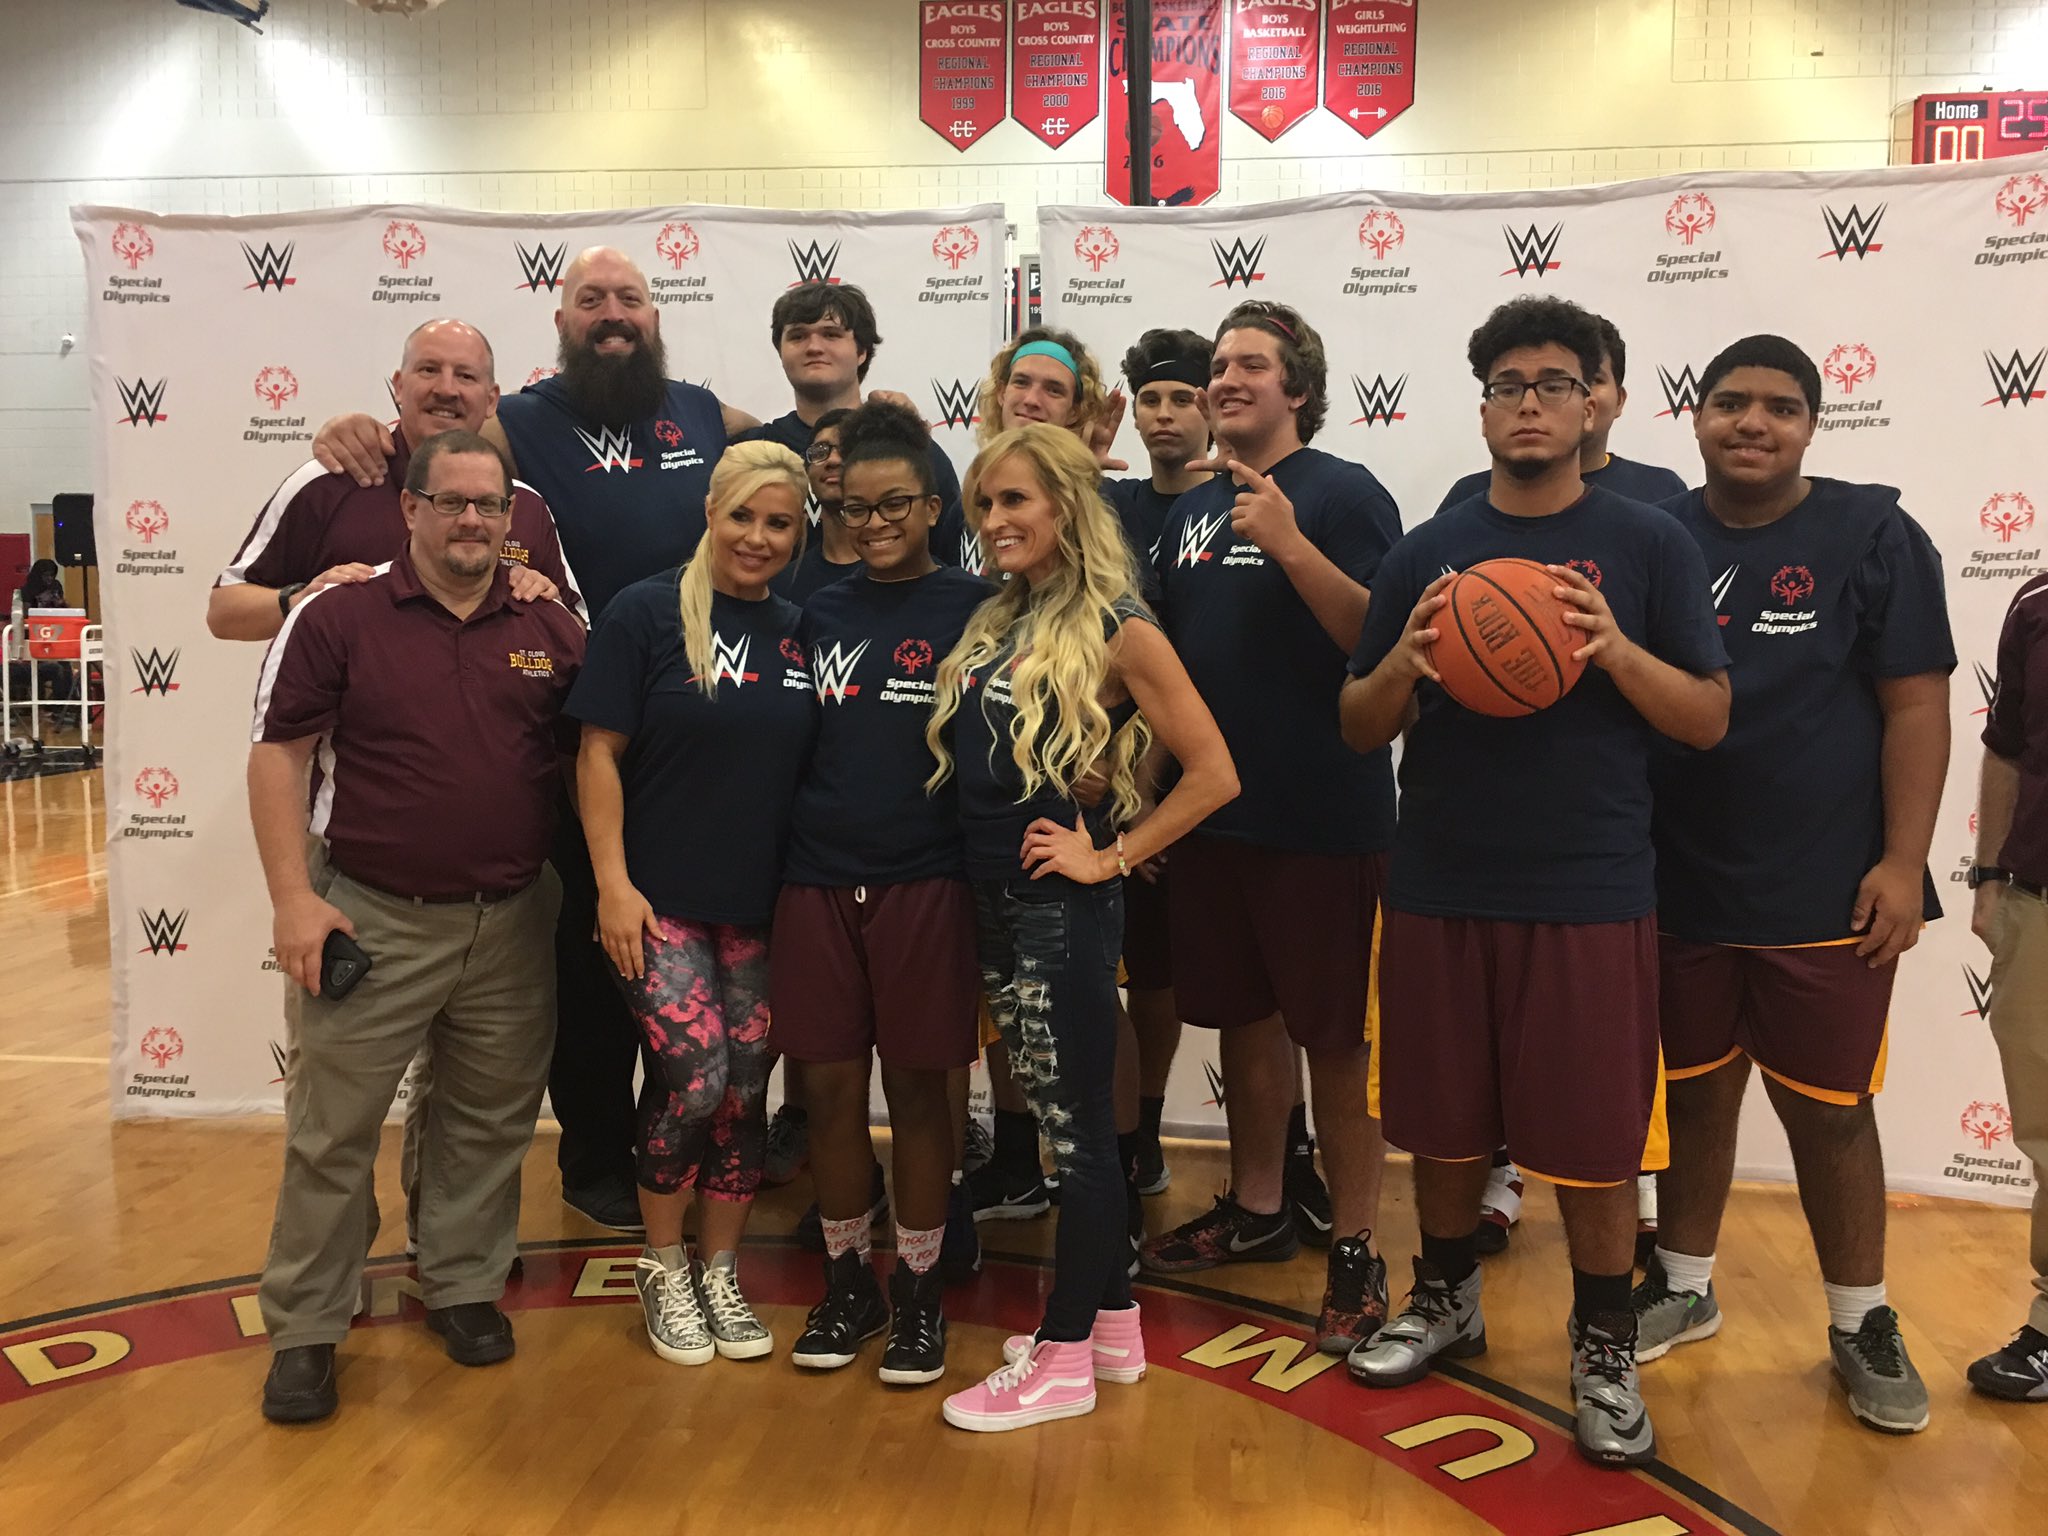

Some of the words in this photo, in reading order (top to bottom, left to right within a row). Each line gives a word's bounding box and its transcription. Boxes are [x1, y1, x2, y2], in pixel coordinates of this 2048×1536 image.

[925, 4, 1002, 24] EAGLES
[1018, 1, 1096, 22] EAGLES
[1355, 10, 1385, 20] GIRLS
[1262, 14, 1289, 24] BOYS
[951, 25, 976, 34] BOYS
[1044, 22, 1069, 31] BOYS
[1243, 27, 1306, 38] BASKETBALL
[1336, 23, 1406, 34] WEIGHTLIFTING
[925, 38, 955, 48] CROSS
[958, 37, 1001, 48] COUNTRY
[1018, 36, 1048, 46] CROSS
[1051, 34, 1095, 45] COUNTRY
[1248, 46, 1302, 60] REGIONAL
[1343, 42, 1398, 56] REGIONAL
[937, 56, 989, 70] REGIONAL
[1030, 53, 1083, 67] REGIONAL
[1242, 66, 1306, 80] CHAMPIONS
[1338, 62, 1403, 76] CHAMPIONS
[932, 76, 994, 90] CHAMPIONS
[1025, 74, 1088, 88] CHAMPIONS
[1261, 86, 1286, 101] 2016
[1357, 83, 1382, 96] 2016
[952, 97, 975, 110] 1999
[1043, 95, 1069, 108] 2000
[1935, 101, 1979, 120] Home
[1935, 125, 1984, 163] 00
[1656, 251, 1722, 268] Special
[1974, 248, 2048, 266] Olympic
[1351, 266, 1410, 280] Special
[1647, 267, 1729, 284] Olympics
[109, 275, 162, 289] Special
[378, 274, 433, 289] Special
[651, 276, 706, 290] Special
[926, 275, 983, 290] Special
[1069, 277, 1125, 291] Special
[1343, 281, 1417, 296] Olympics
[103, 290, 170, 304] Olympics
[372, 289, 441, 303] Olympics
[918, 289, 989, 305] Olympics
[1062, 291, 1132, 305] Olympics
[250, 416, 305, 431] Special
[1818, 416, 1890, 431] lympics
[243, 430, 313, 444] Olympics
[661, 448, 696, 461] Special
[660, 457, 704, 470] Olympics
[122, 549, 176, 563] Special
[1223, 556, 1264, 566] Olympics
[1970, 549, 2041, 564] Special
[116, 562, 184, 576] Olympics
[1760, 610, 1816, 622] Special
[1471, 594, 1520, 654] ROCK
[1751, 621, 1818, 635] Olympics
[40, 626, 52, 638] G
[130, 813, 186, 828] Special
[124, 827, 194, 840] Olympics
[133, 1073, 189, 1087] Special
[126, 1085, 196, 1100] Olympics
[1952, 1152, 2023, 1171] Special
[1943, 1166, 2032, 1188] Olympics
